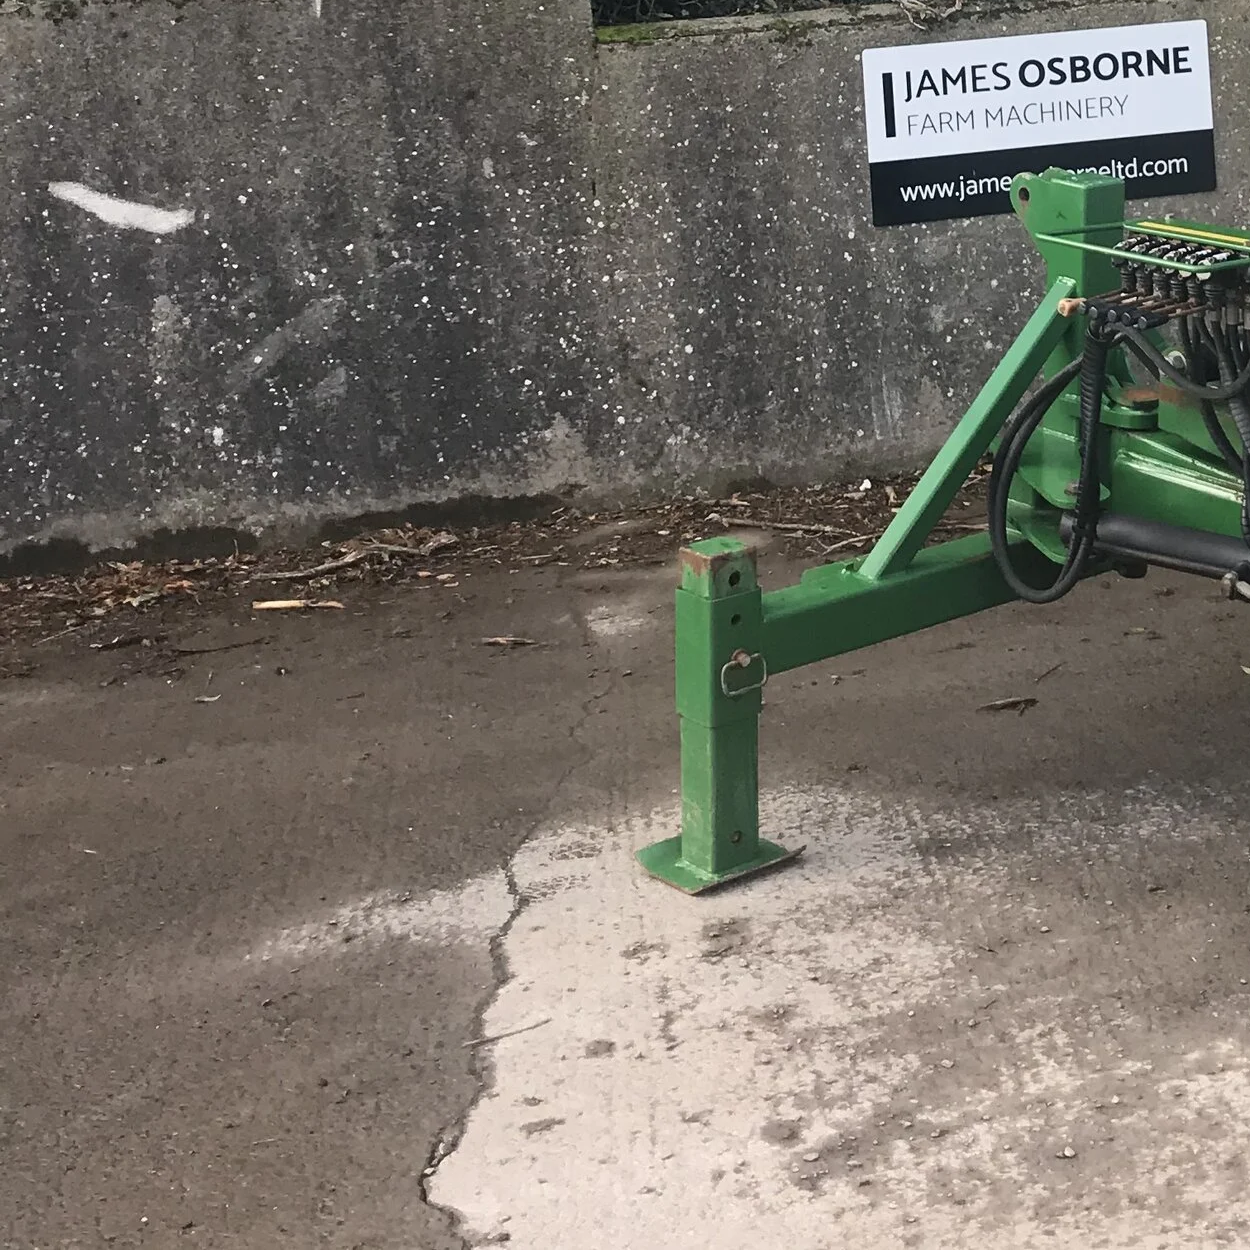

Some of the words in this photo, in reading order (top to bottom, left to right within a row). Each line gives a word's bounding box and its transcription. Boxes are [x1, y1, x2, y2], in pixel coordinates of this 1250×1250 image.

[905, 62, 1011, 102] JAMES
[1018, 46, 1192, 88] OSBORNE
[908, 110, 975, 136] FARM
[985, 95, 1129, 129] MACHINERY
